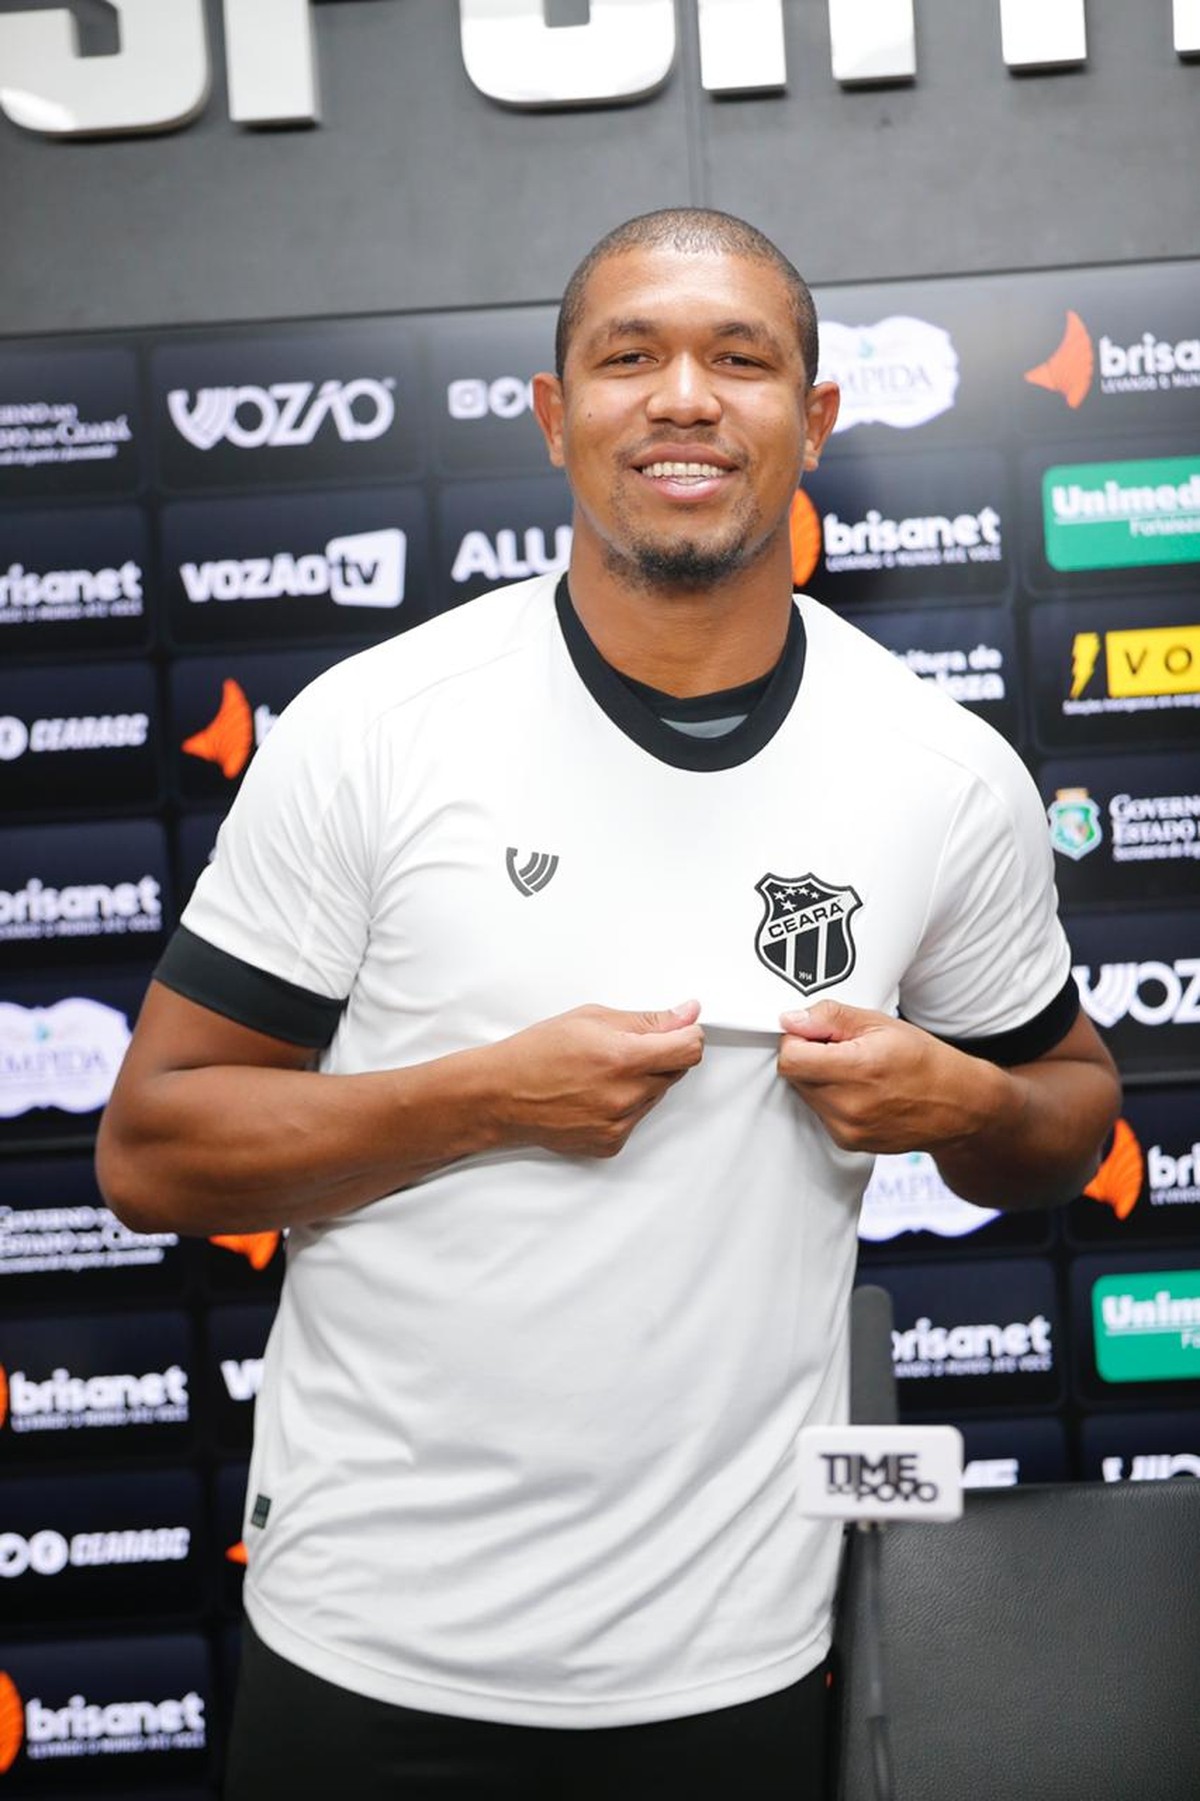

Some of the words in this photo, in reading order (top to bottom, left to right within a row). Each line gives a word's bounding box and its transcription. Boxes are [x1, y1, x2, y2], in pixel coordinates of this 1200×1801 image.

[823, 506, 1001, 556] brisanet
[892, 1315, 1051, 1361] risanet
[10, 1365, 189, 1414] brisanet
[819, 1453, 918, 1484] TIME
[26, 1692, 205, 1742] brisanet
